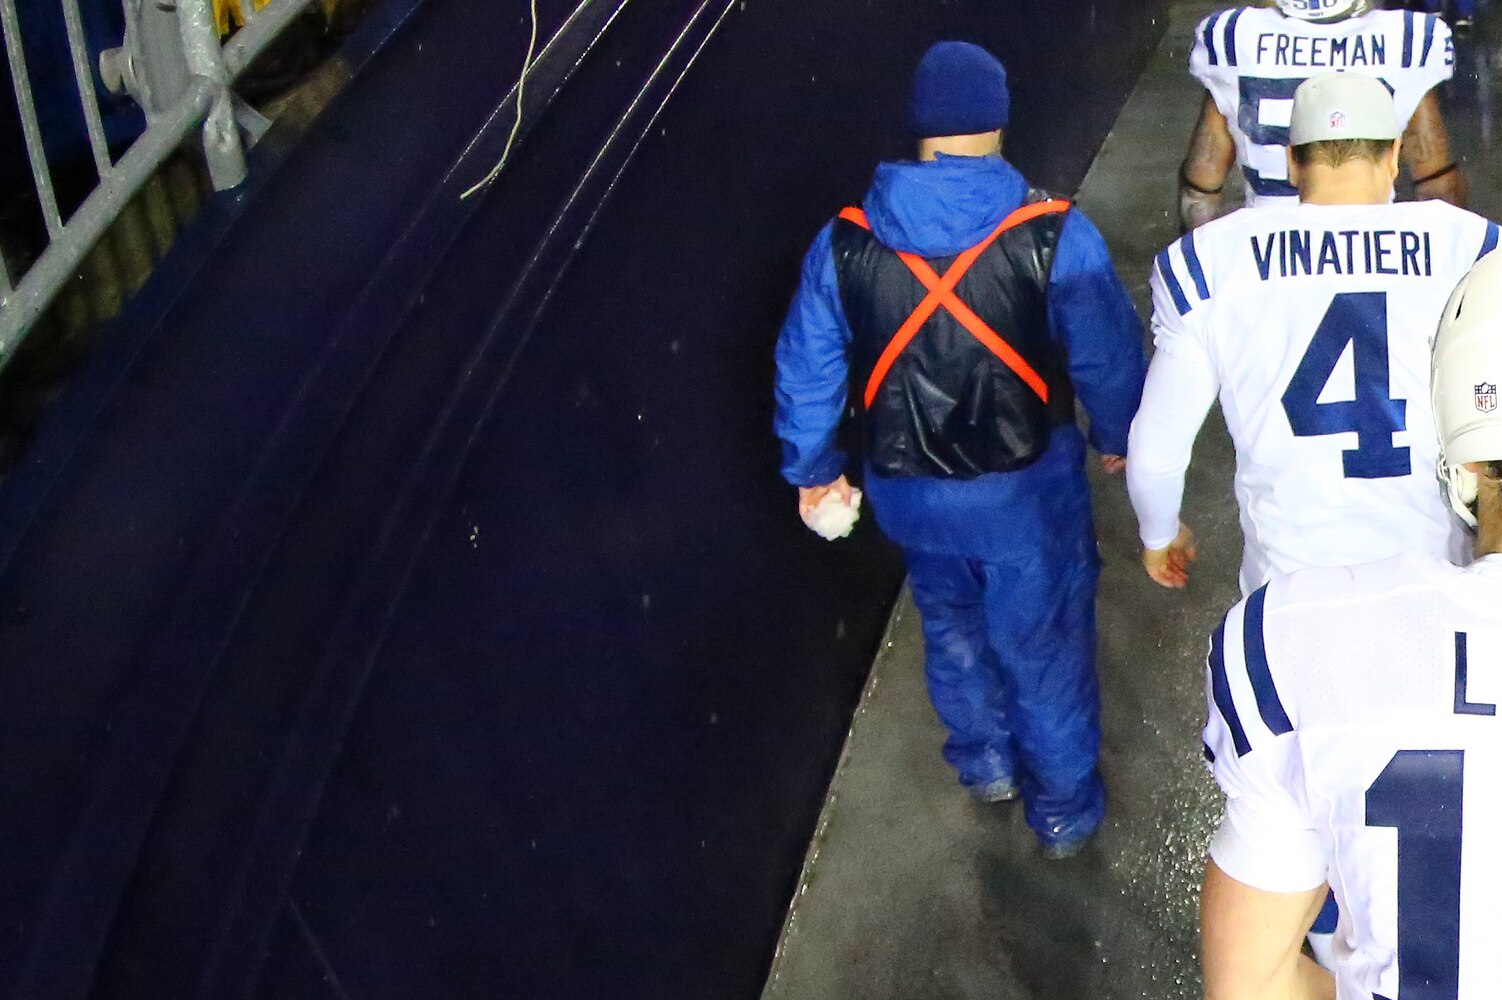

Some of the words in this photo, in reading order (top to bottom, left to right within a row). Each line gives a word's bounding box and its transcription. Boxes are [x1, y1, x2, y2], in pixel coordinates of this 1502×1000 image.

[1256, 33, 1386, 67] FREEMAN
[1251, 231, 1432, 278] VINATIERI
[1281, 291, 1412, 479] 4
[1477, 395, 1495, 410] NFL
